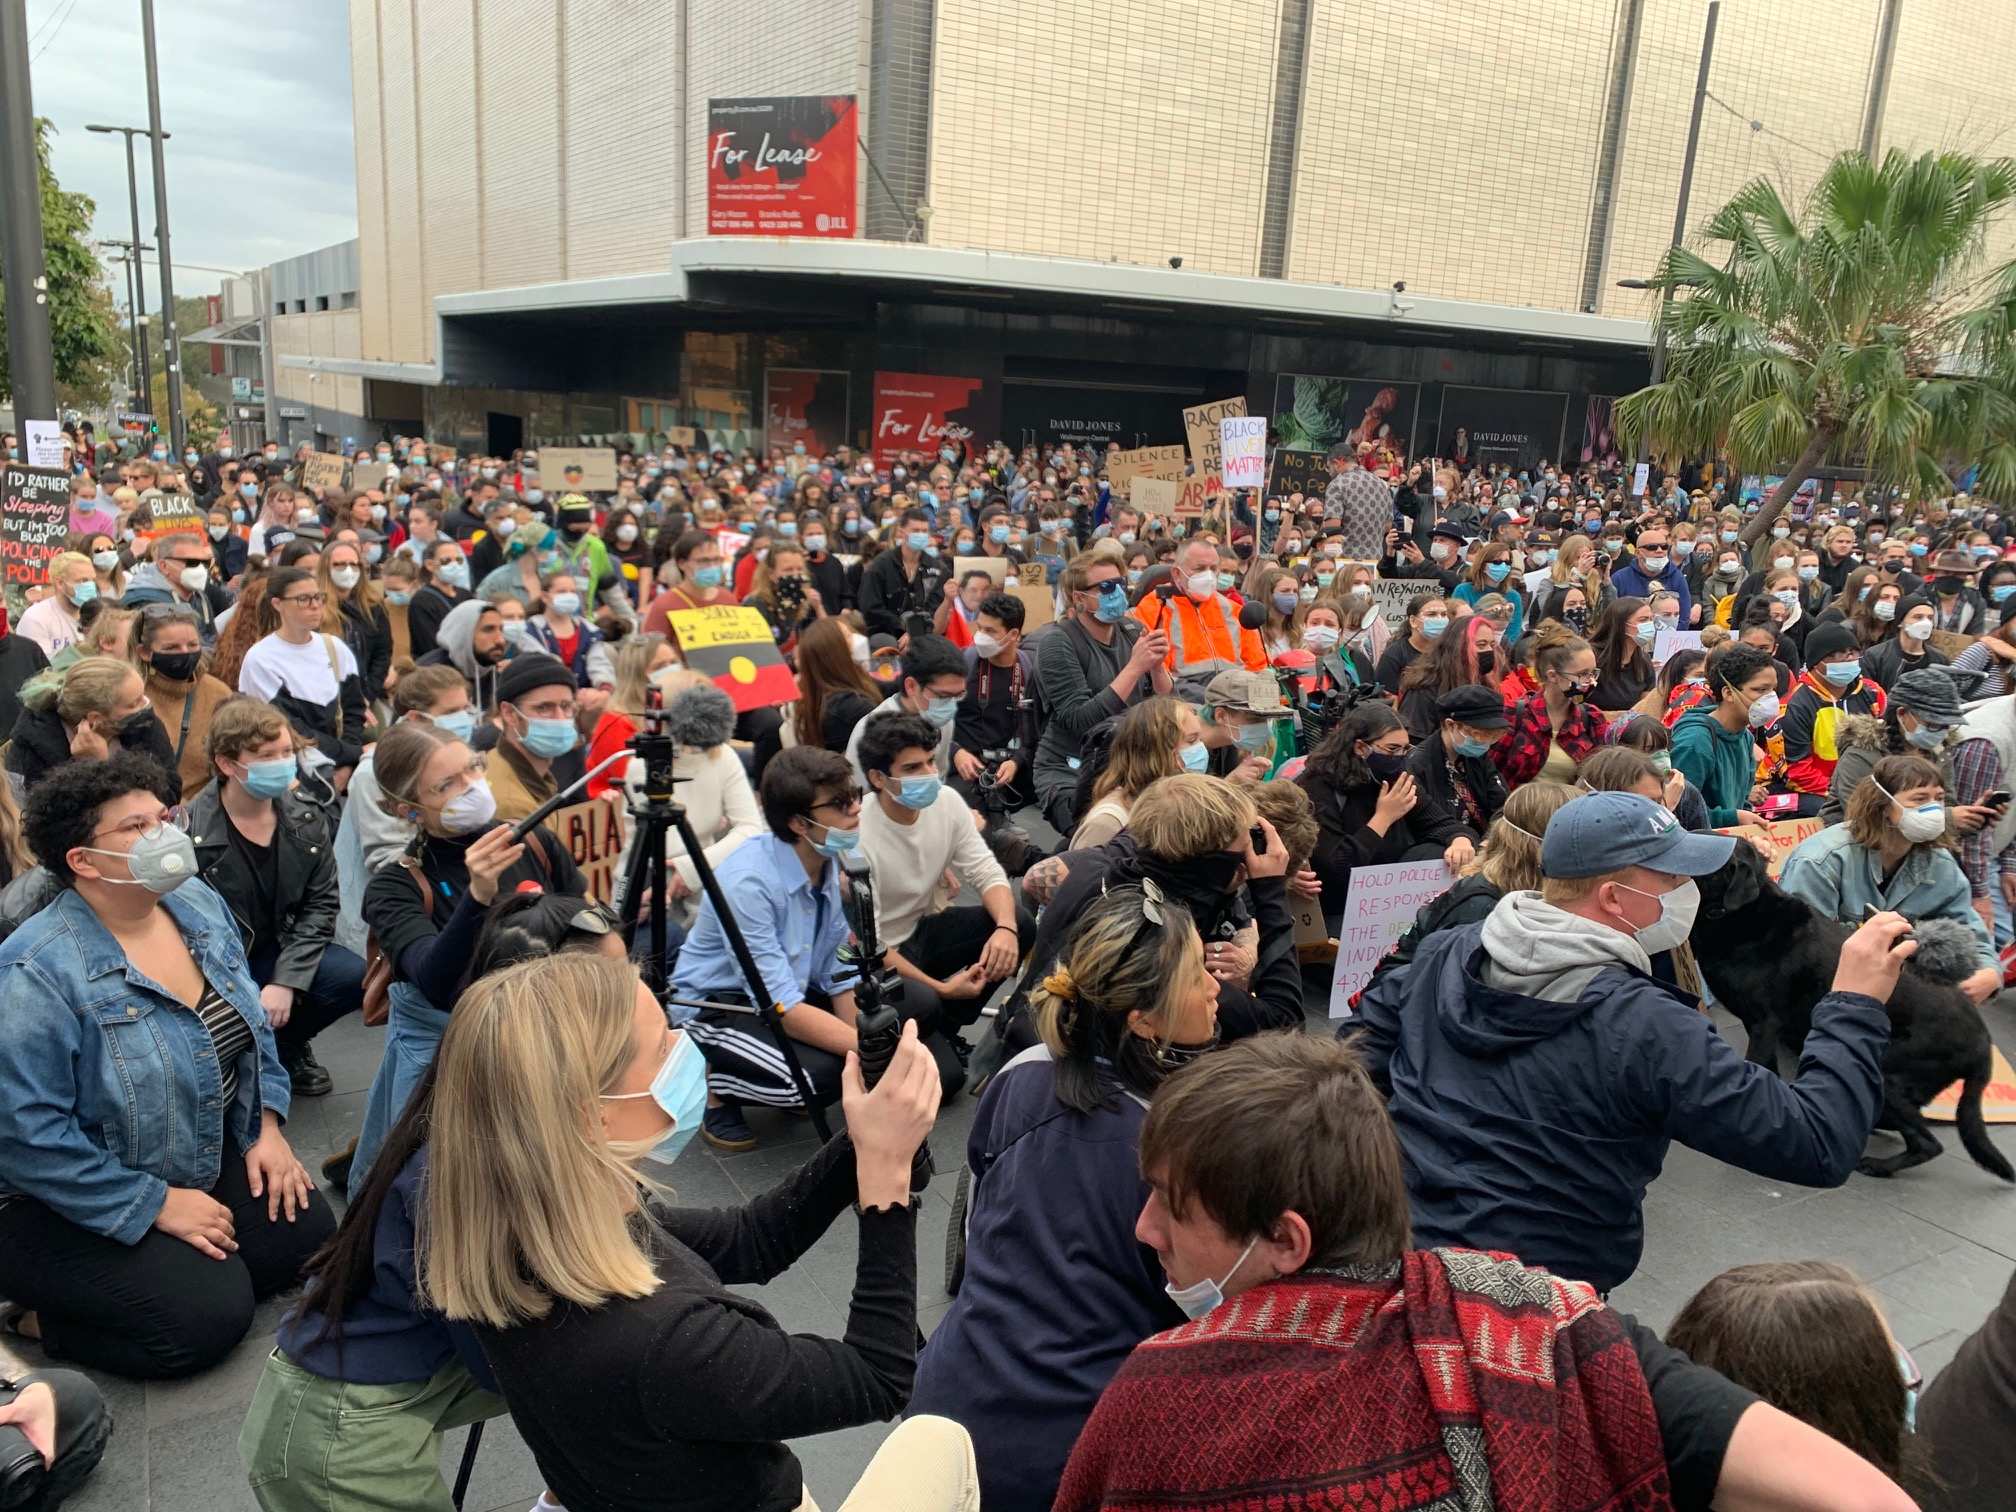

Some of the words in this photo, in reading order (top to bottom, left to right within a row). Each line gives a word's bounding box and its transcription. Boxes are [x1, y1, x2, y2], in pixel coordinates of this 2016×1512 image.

[711, 131, 749, 169] For
[754, 132, 823, 172] Lease
[1185, 399, 1247, 430] RACISM
[878, 408, 912, 439] For
[917, 411, 975, 443] Lease
[1050, 419, 1085, 431] DAVID
[1086, 421, 1122, 432] JONES
[1223, 421, 1264, 441] BLACK
[1473, 432, 1500, 441] DAVID
[1501, 433, 1529, 443] JONES
[1112, 448, 1180, 466] SILENCE
[1201, 443, 1222, 456] TH
[1225, 456, 1264, 478] MATTER
[8, 471, 25, 486] I'D
[28, 473, 70, 492] RATHER
[22, 487, 37, 499] BE
[4, 495, 65, 524] Sleeping
[150, 496, 193, 517] BLACK
[3, 518, 26, 532] BUT
[43, 523, 68, 538] TOO
[20, 530, 49, 545] BUSY
[7, 563, 50, 584] POLI
[23, 558, 42, 569] THE
[569, 803, 622, 866] BLA
[1352, 872, 1394, 890] HOLD
[1399, 867, 1443, 884] POLICE
[1346, 924, 1381, 943] THE
